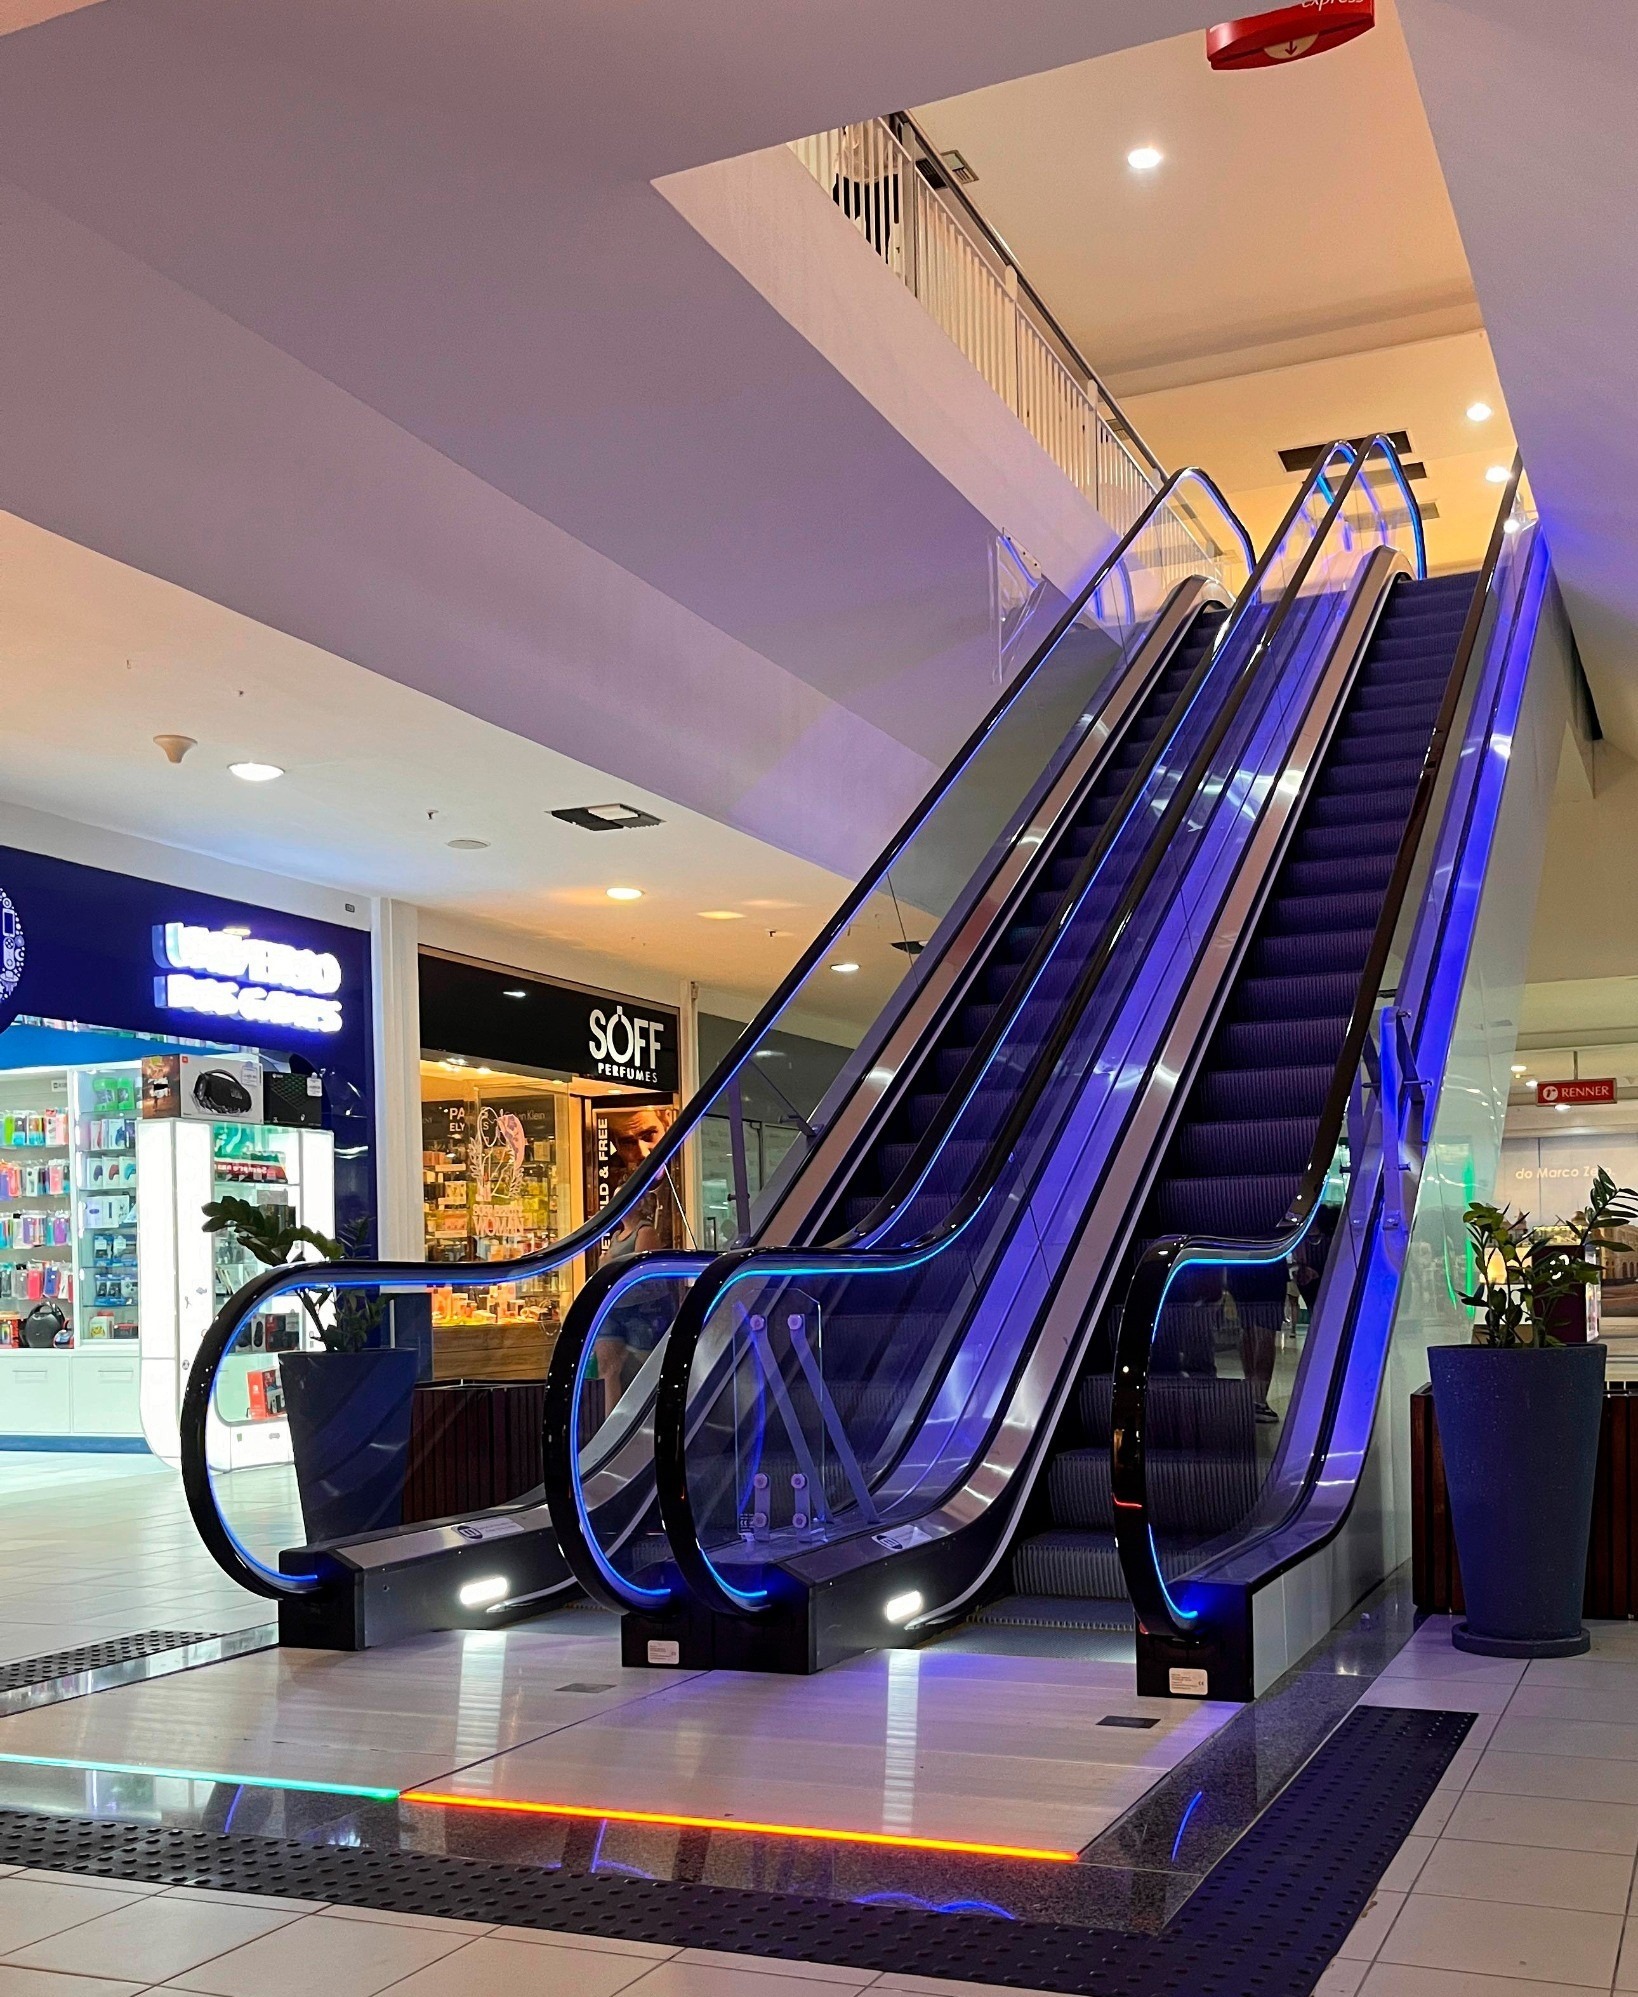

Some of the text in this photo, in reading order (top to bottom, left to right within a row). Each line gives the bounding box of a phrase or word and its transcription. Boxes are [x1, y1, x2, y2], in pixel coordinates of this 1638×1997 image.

[588, 1005, 664, 1069] SOFF
[597, 1062, 658, 1083] PERFUMES
[1561, 1086, 1610, 1098] RENNER
[598, 1118, 608, 1161] FREE
[599, 1166, 609, 1178] &
[1515, 1165, 1616, 1179] do Marco Zeo.
